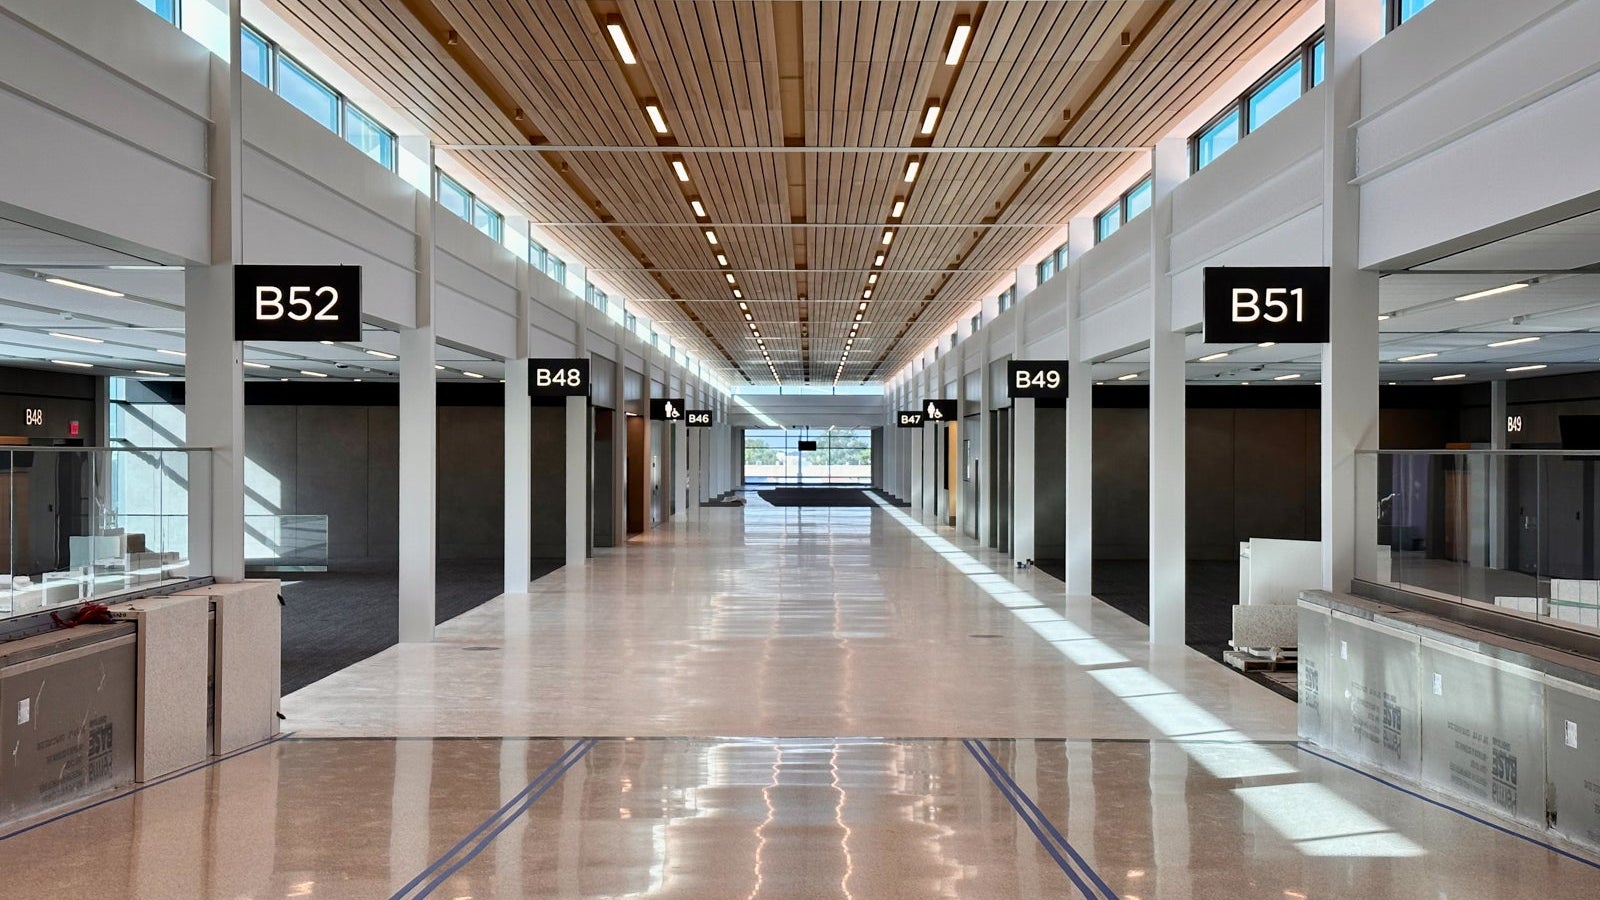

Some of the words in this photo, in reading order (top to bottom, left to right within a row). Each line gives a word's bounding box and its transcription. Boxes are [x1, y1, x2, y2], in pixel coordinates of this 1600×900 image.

[255, 285, 339, 321] B52
[1231, 287, 1305, 323] B51
[536, 368, 581, 387] B48
[1015, 369, 1061, 389] B49
[25, 408, 42, 426] B48
[688, 413, 709, 424] B46
[901, 414, 920, 424] B47
[1507, 415, 1522, 432] B49
[1492, 749, 1517, 785] BASE
